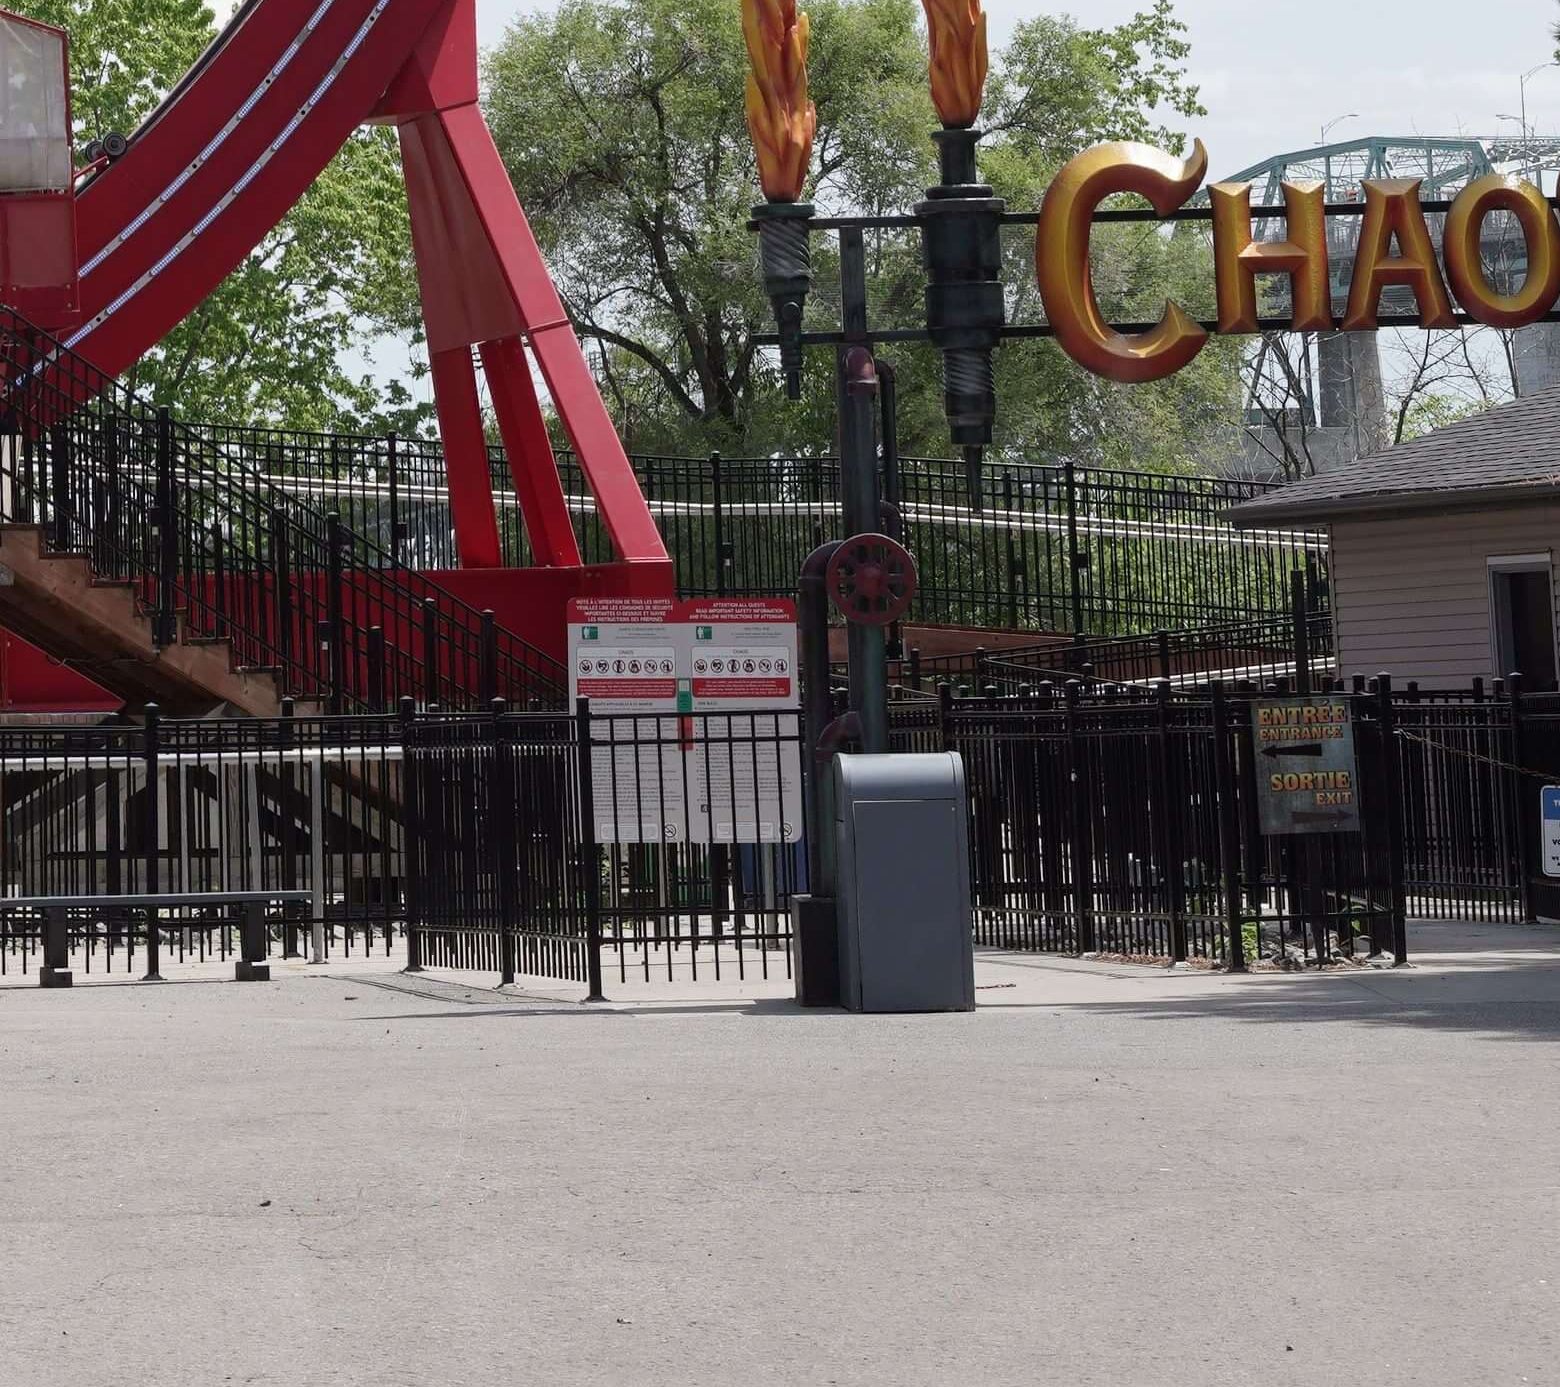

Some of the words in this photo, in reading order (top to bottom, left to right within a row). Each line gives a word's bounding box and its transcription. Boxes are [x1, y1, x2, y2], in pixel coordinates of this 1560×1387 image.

[1258, 700, 1347, 725] ENTRÉE
[1259, 725, 1344, 741] ENTRANCE
[1270, 771, 1351, 792] SORTIE
[1316, 791, 1352, 805] EXIT
